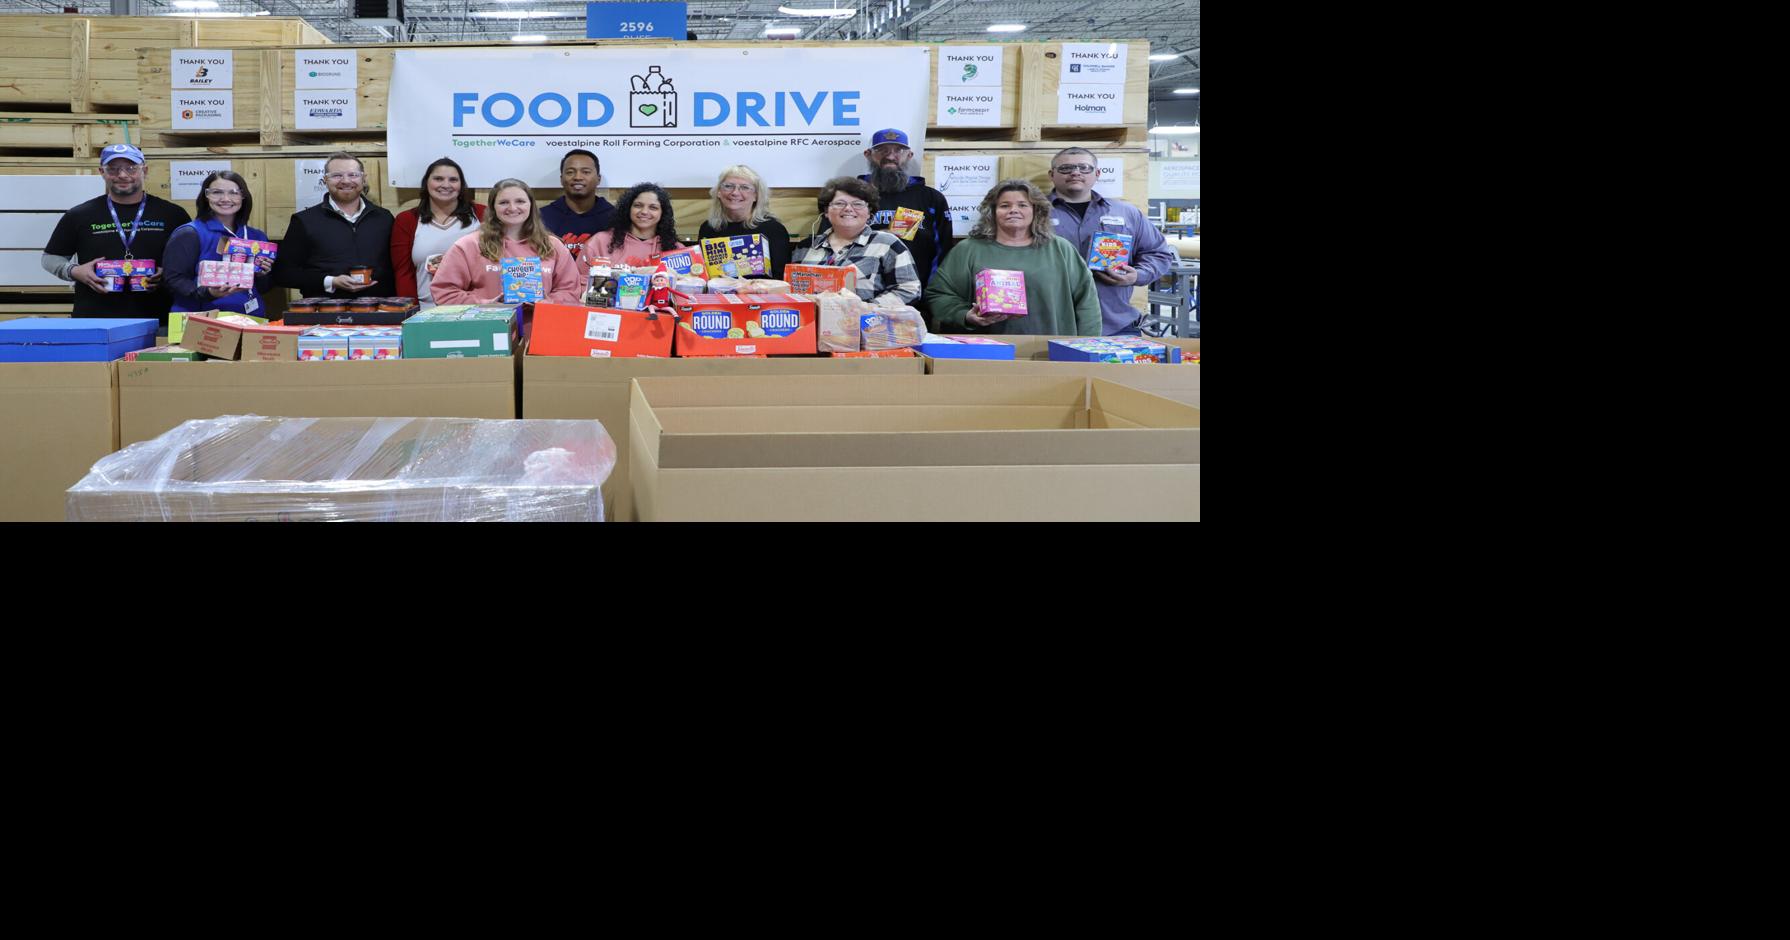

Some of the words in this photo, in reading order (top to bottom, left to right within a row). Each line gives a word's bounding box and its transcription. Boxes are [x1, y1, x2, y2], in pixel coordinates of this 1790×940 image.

[620, 22, 654, 32] 2596
[453, 92, 615, 128] FOOD
[693, 91, 861, 127] DRIVE
[1074, 104, 1106, 112] Holman
[452, 139, 536, 148] TogetherWeCare
[546, 139, 601, 149] voestalpine
[602, 139, 620, 147] Roll
[622, 139, 661, 149] Forming
[663, 139, 721, 149] Corporation
[733, 138, 788, 148] voestalpine
[790, 138, 809, 146] RFC
[811, 138, 862, 148] Aerospace
[90, 220, 165, 230] TogetereCare
[705, 241, 726, 250] BIG
[693, 315, 730, 330] ROUND
[761, 313, 798, 328] ROUND
